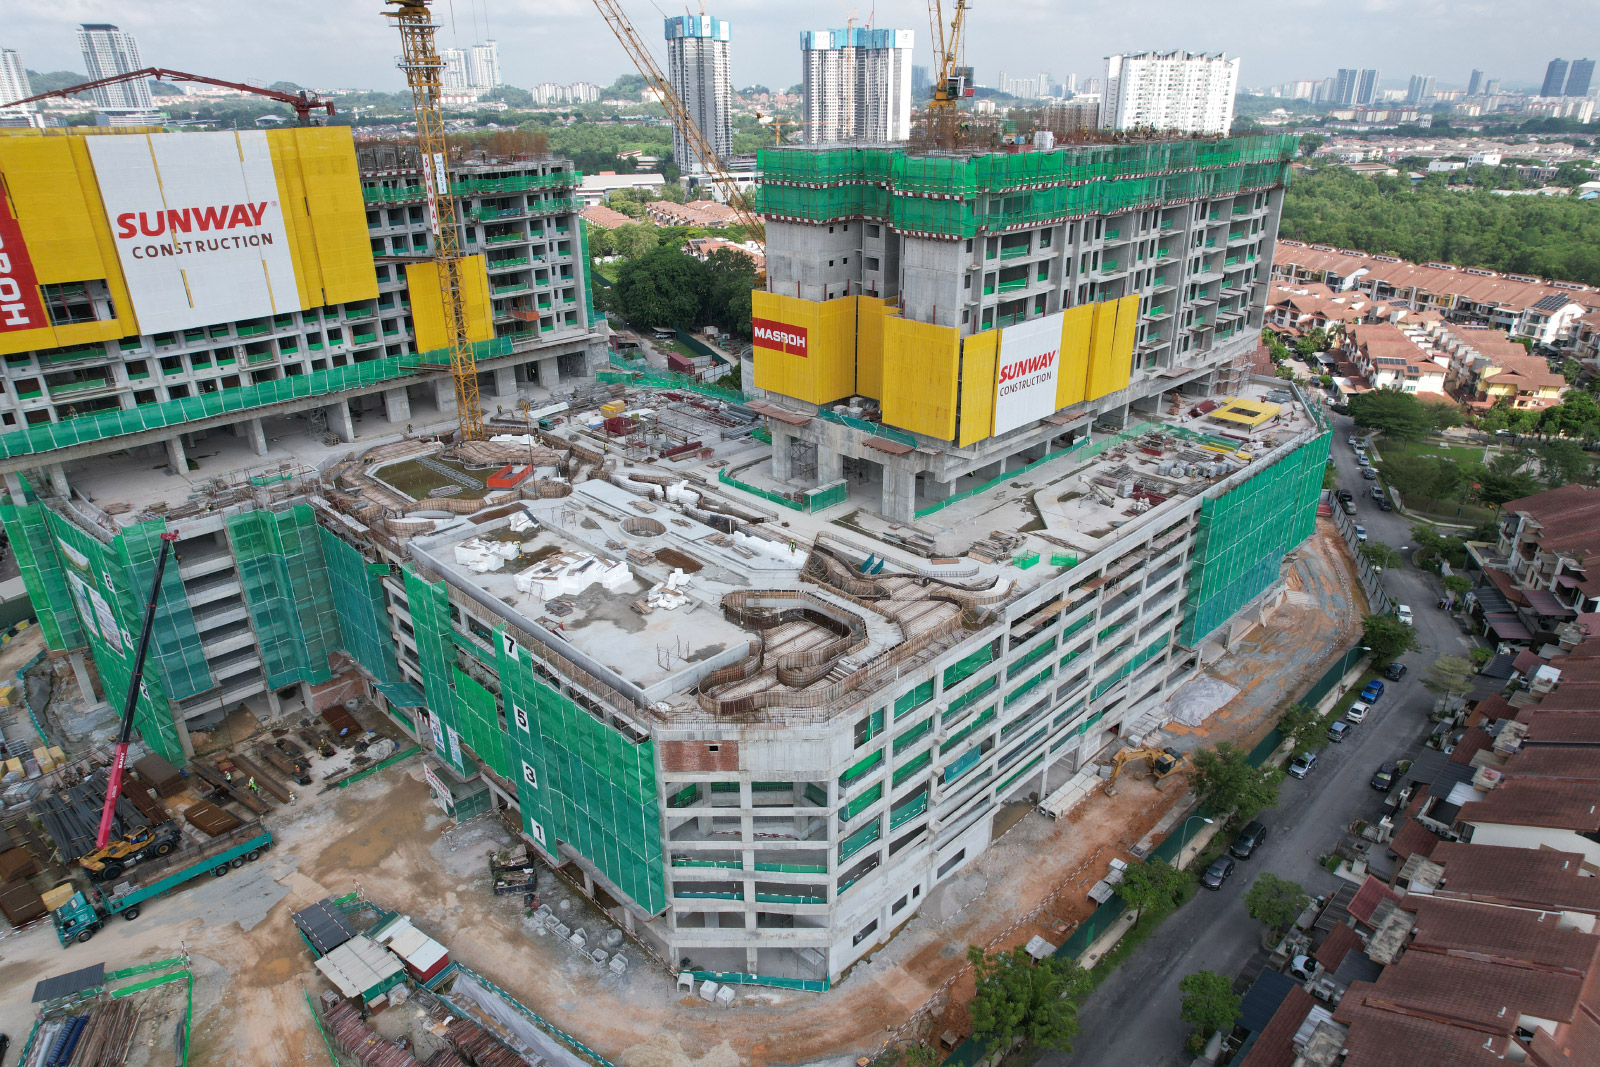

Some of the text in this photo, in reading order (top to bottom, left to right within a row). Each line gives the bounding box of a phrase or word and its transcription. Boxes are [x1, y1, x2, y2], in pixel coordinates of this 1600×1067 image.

[424, 157, 438, 232] SUNWAY
[116, 201, 268, 239] SUNWAY
[132, 232, 274, 259] CONSTRUCTION
[998, 349, 1056, 385] SUNWAY
[999, 371, 1052, 397] CONSTRUCTION
[504, 635, 515, 653] 7
[517, 710, 527, 727] 5
[118, 752, 126, 769] SANY
[525, 765, 536, 783] 3
[535, 824, 544, 840] 1
